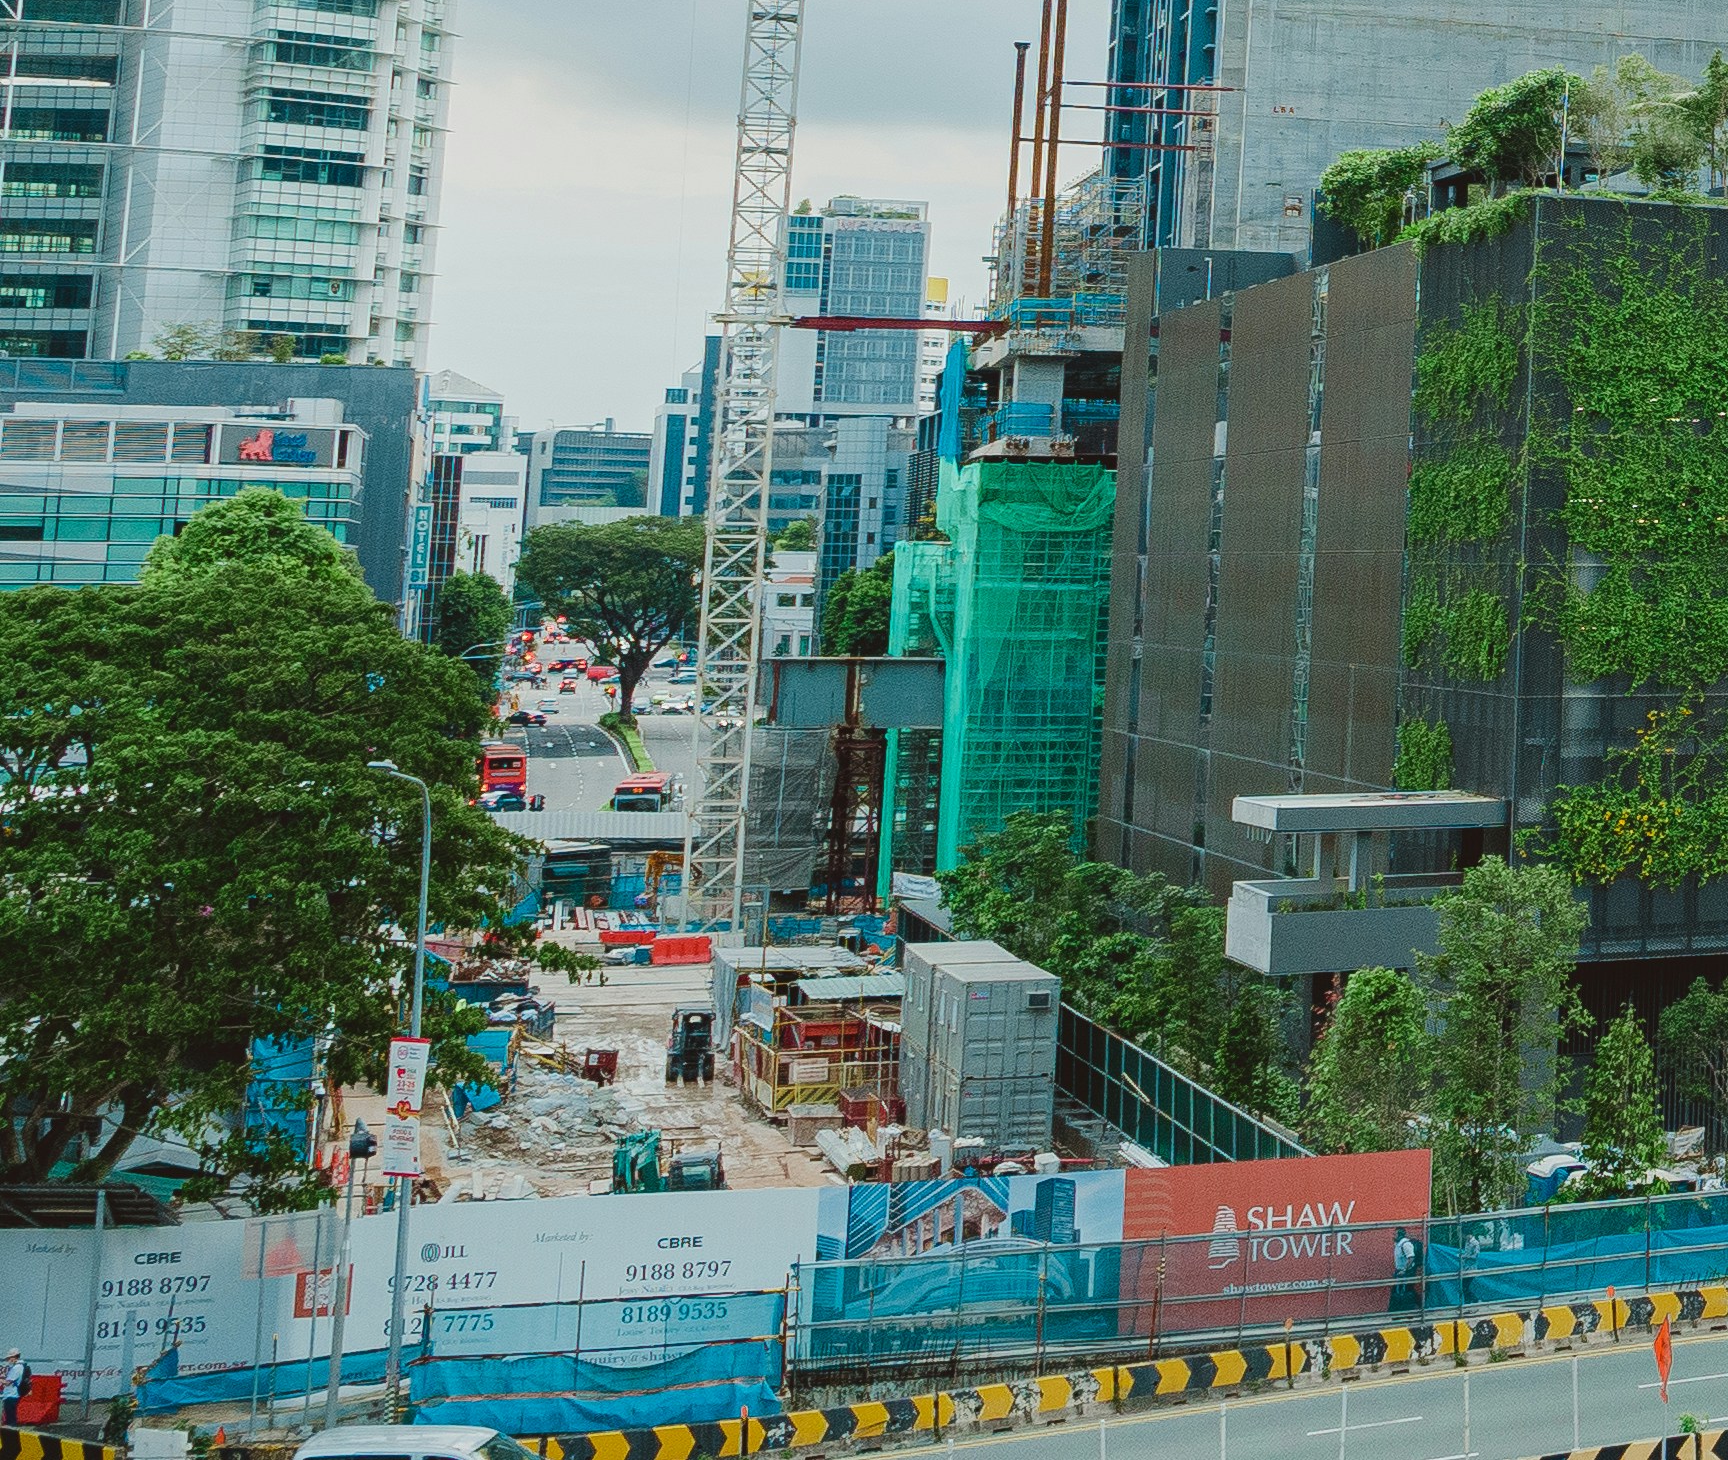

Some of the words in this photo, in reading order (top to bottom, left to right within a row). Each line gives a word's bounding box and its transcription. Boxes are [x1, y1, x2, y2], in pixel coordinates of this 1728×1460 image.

[416, 509, 429, 565] HOTEL
[1247, 1200, 1356, 1231] SHAW
[441, 1245, 469, 1259] JLL
[658, 1236, 704, 1249] CBRE
[1250, 1231, 1354, 1262] TOWER
[134, 1251, 182, 1265] CBRE
[446, 1271, 498, 1290] 4477
[625, 1262, 675, 1283] 9188
[682, 1260, 732, 1279] 8797
[101, 1278, 153, 1298] 9188
[159, 1275, 211, 1294] 8797
[443, 1313, 495, 1333] 7775
[621, 1303, 671, 1324] 8189
[678, 1301, 728, 1321] 9535
